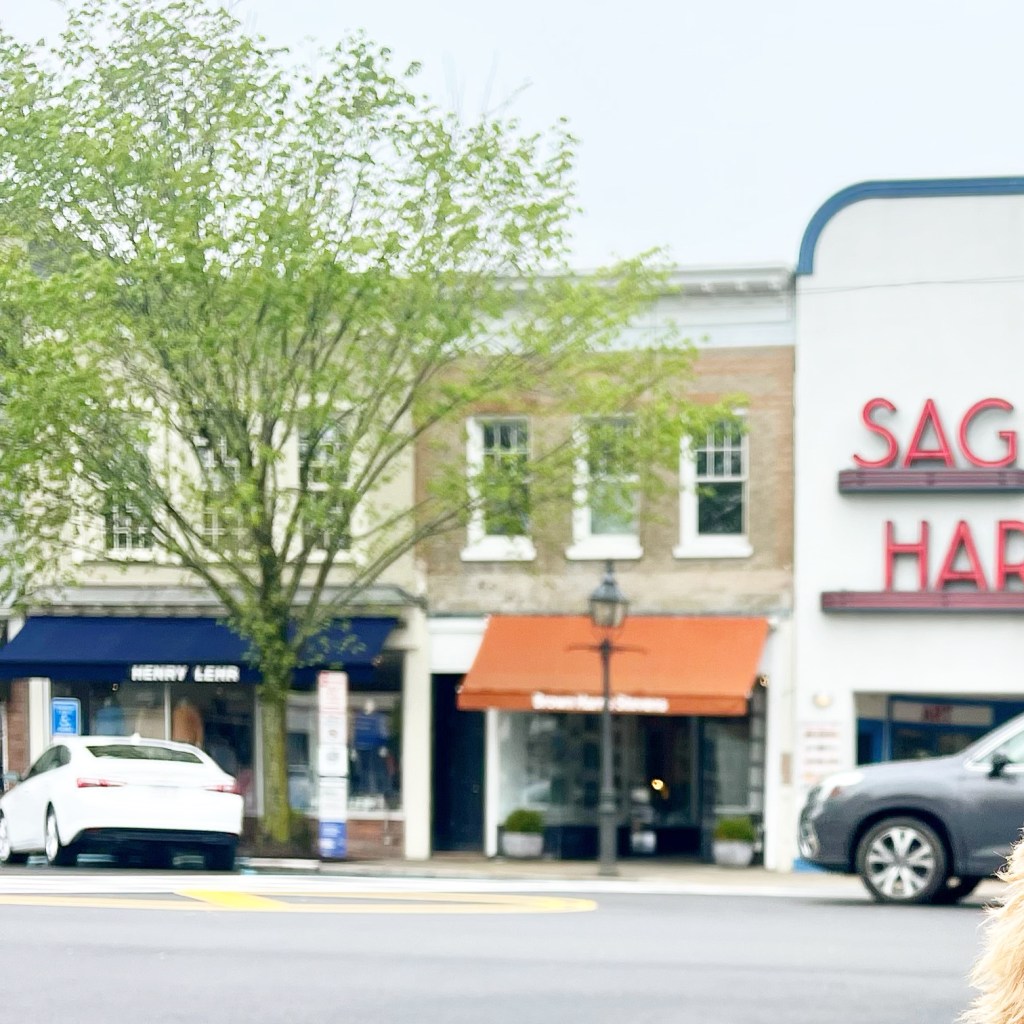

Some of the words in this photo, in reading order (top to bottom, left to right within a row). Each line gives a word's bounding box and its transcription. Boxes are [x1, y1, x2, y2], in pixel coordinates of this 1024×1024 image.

[852, 397, 1018, 468] SAG
[131, 664, 188, 681] HENRY
[194, 665, 240, 682] LEHR
